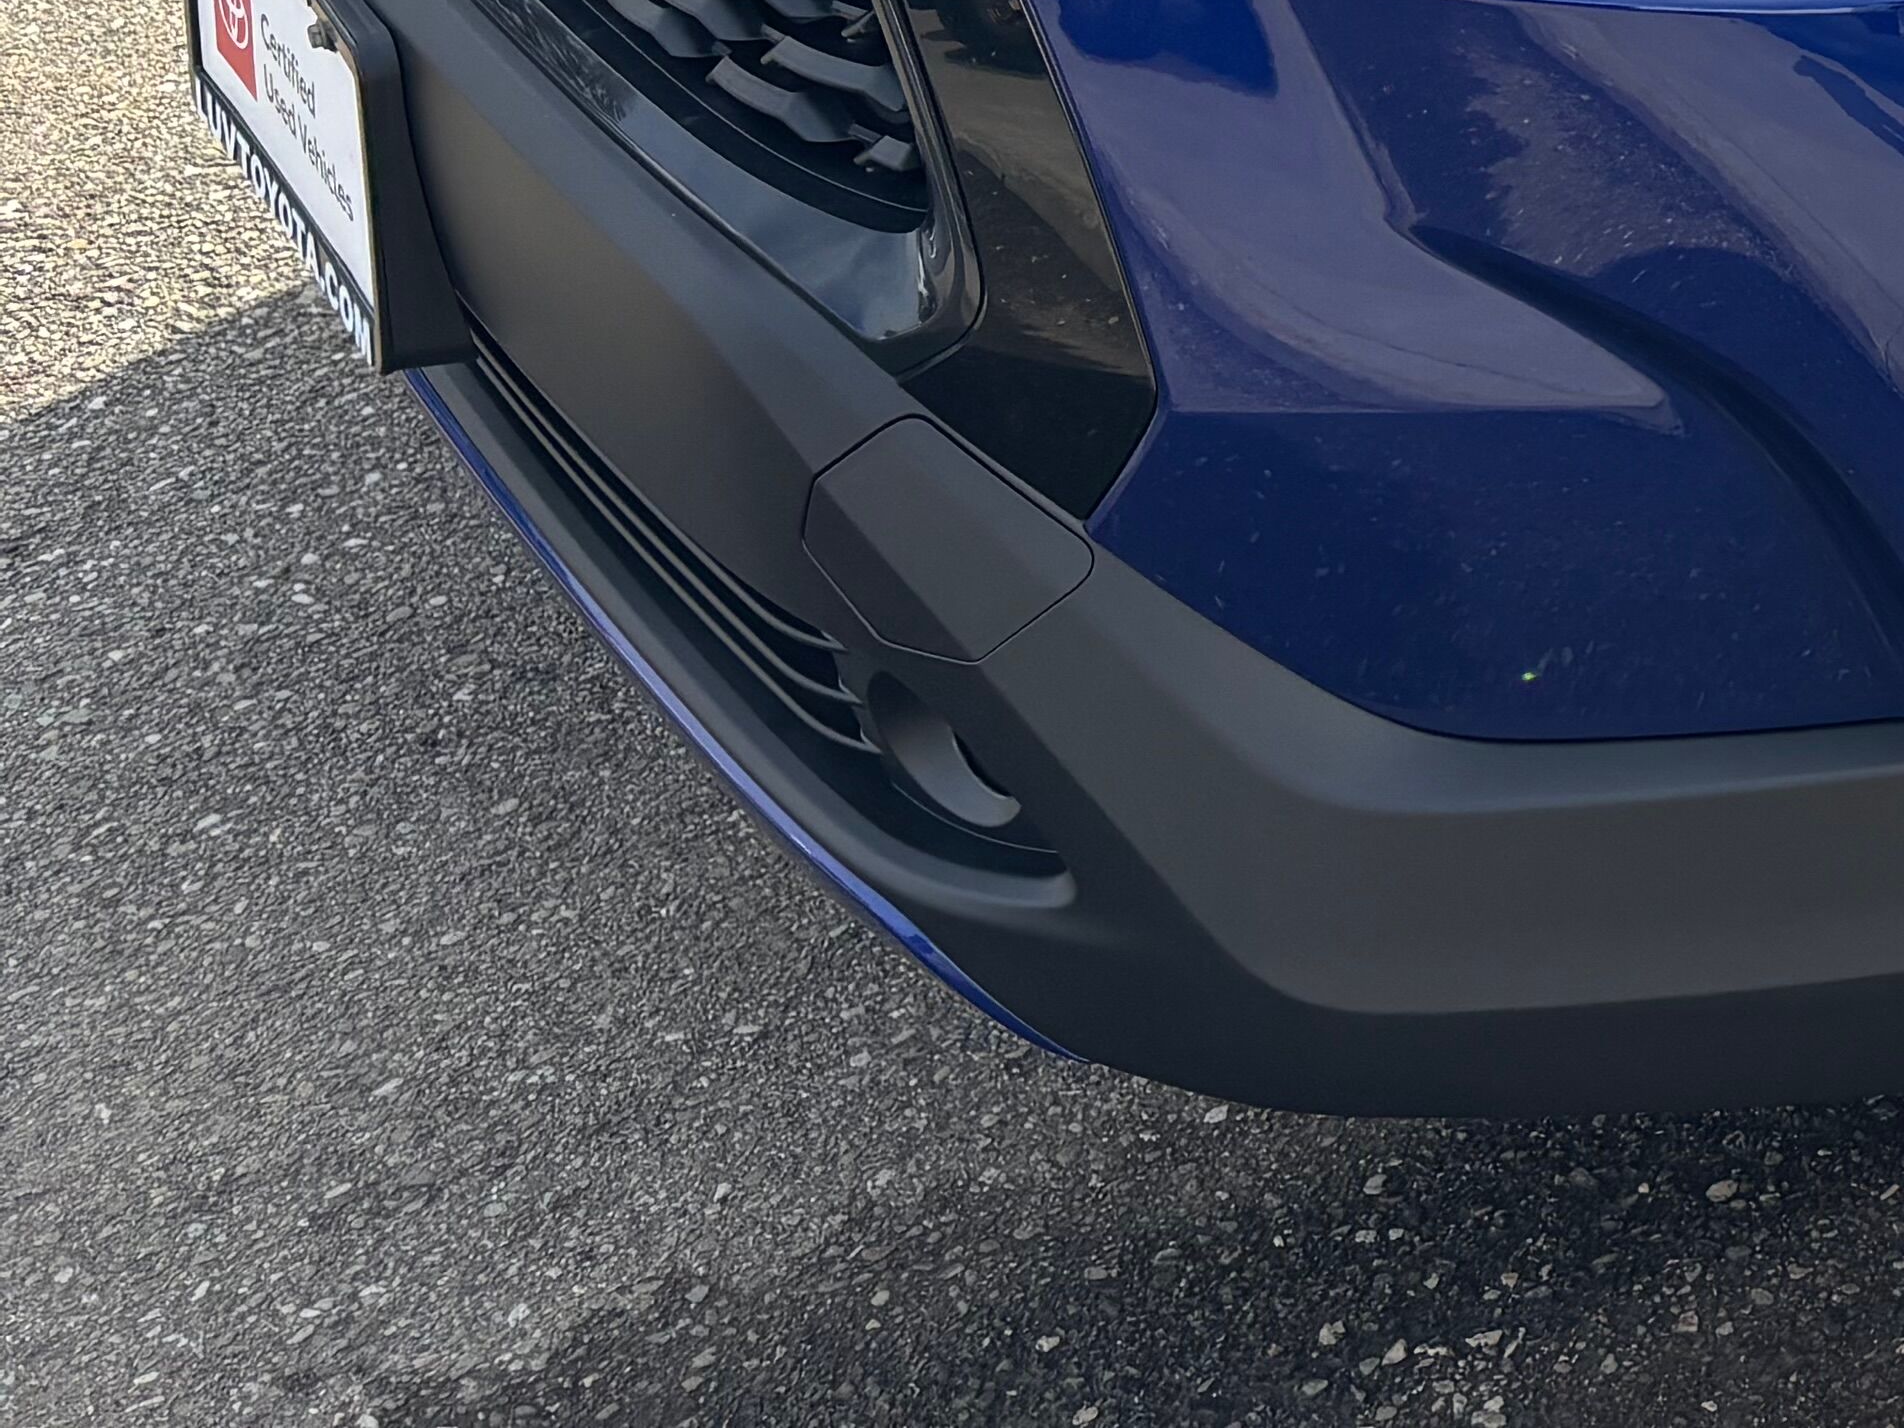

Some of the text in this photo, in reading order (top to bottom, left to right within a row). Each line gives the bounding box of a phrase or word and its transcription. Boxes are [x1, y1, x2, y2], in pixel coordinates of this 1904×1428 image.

[260, 13, 316, 119] Certified
[264, 63, 355, 222] Used Vehicles
[195, 77, 372, 366] LUVTOYOTA.COM
